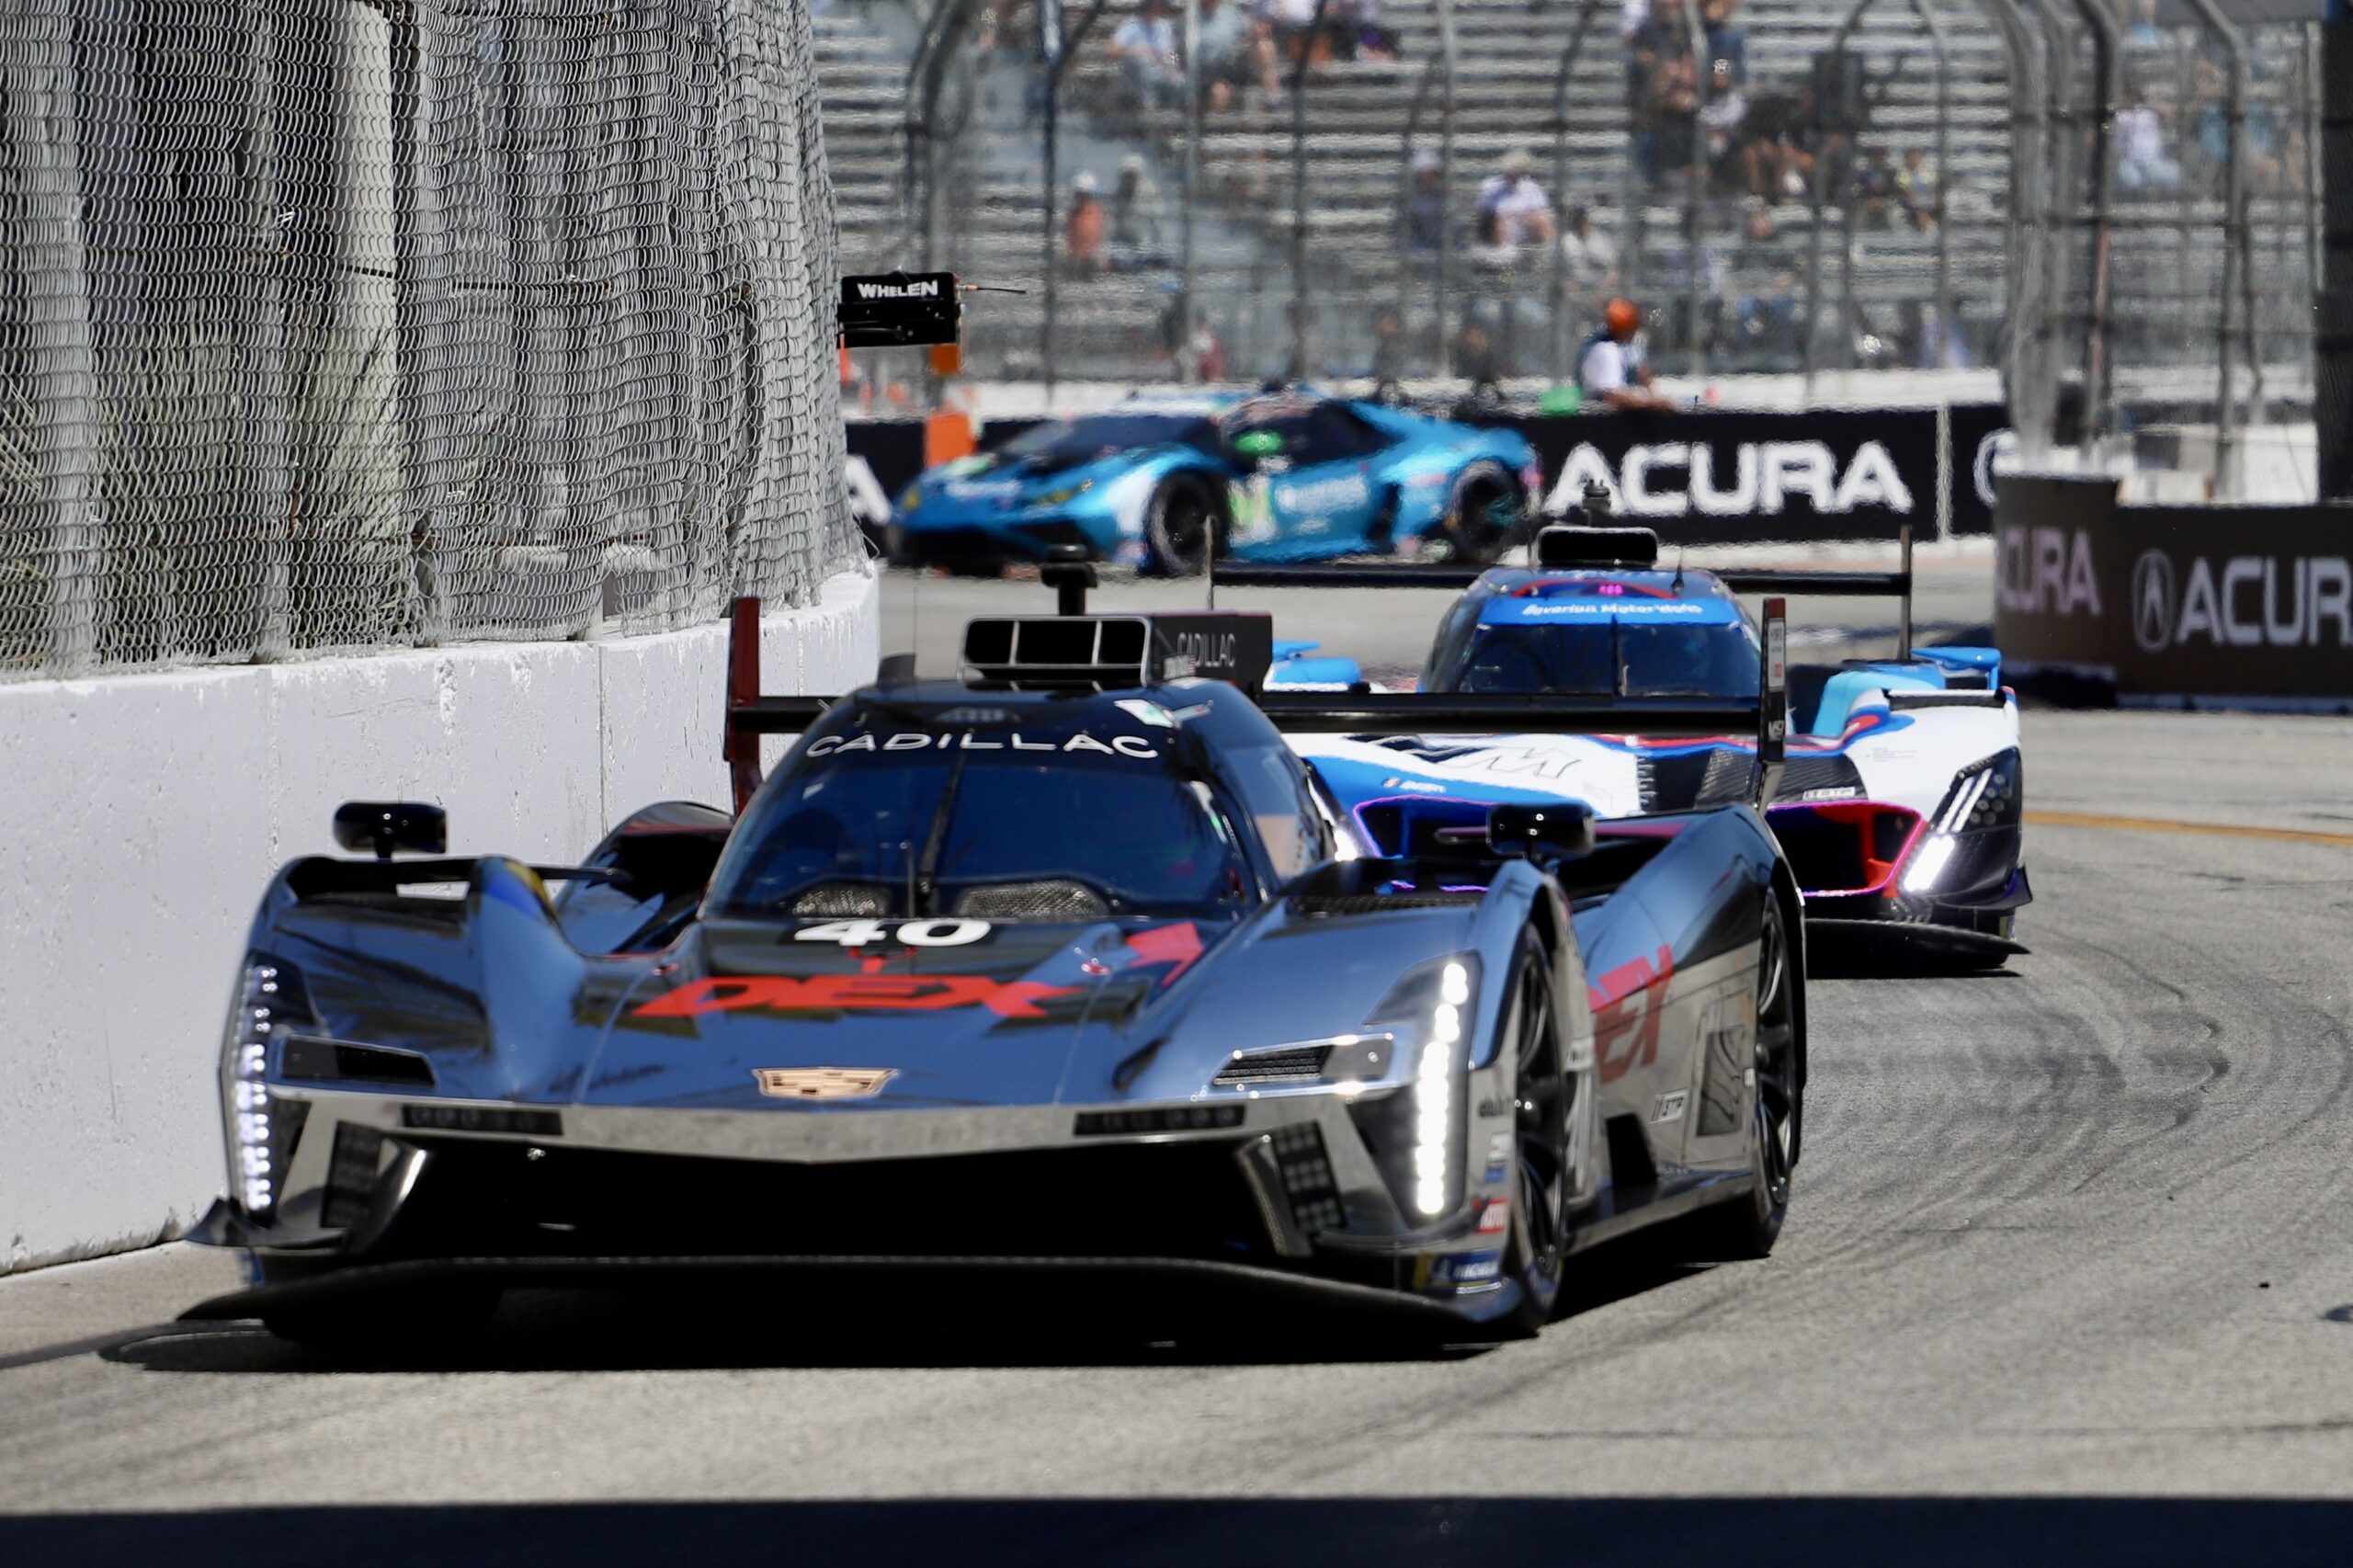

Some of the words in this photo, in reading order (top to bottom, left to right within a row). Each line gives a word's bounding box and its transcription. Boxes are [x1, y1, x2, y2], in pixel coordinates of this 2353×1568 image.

[857, 280, 938, 298] WHELEN
[1544, 440, 1915, 516] ACURA
[1522, 604, 1597, 617] Bavarian
[1601, 604, 1653, 615] Motor
[2177, 555, 2353, 646] ACUR
[1177, 631, 1235, 668] CADILLAC
[806, 733, 1159, 759] CADILLAC
[794, 918, 992, 947] 40
